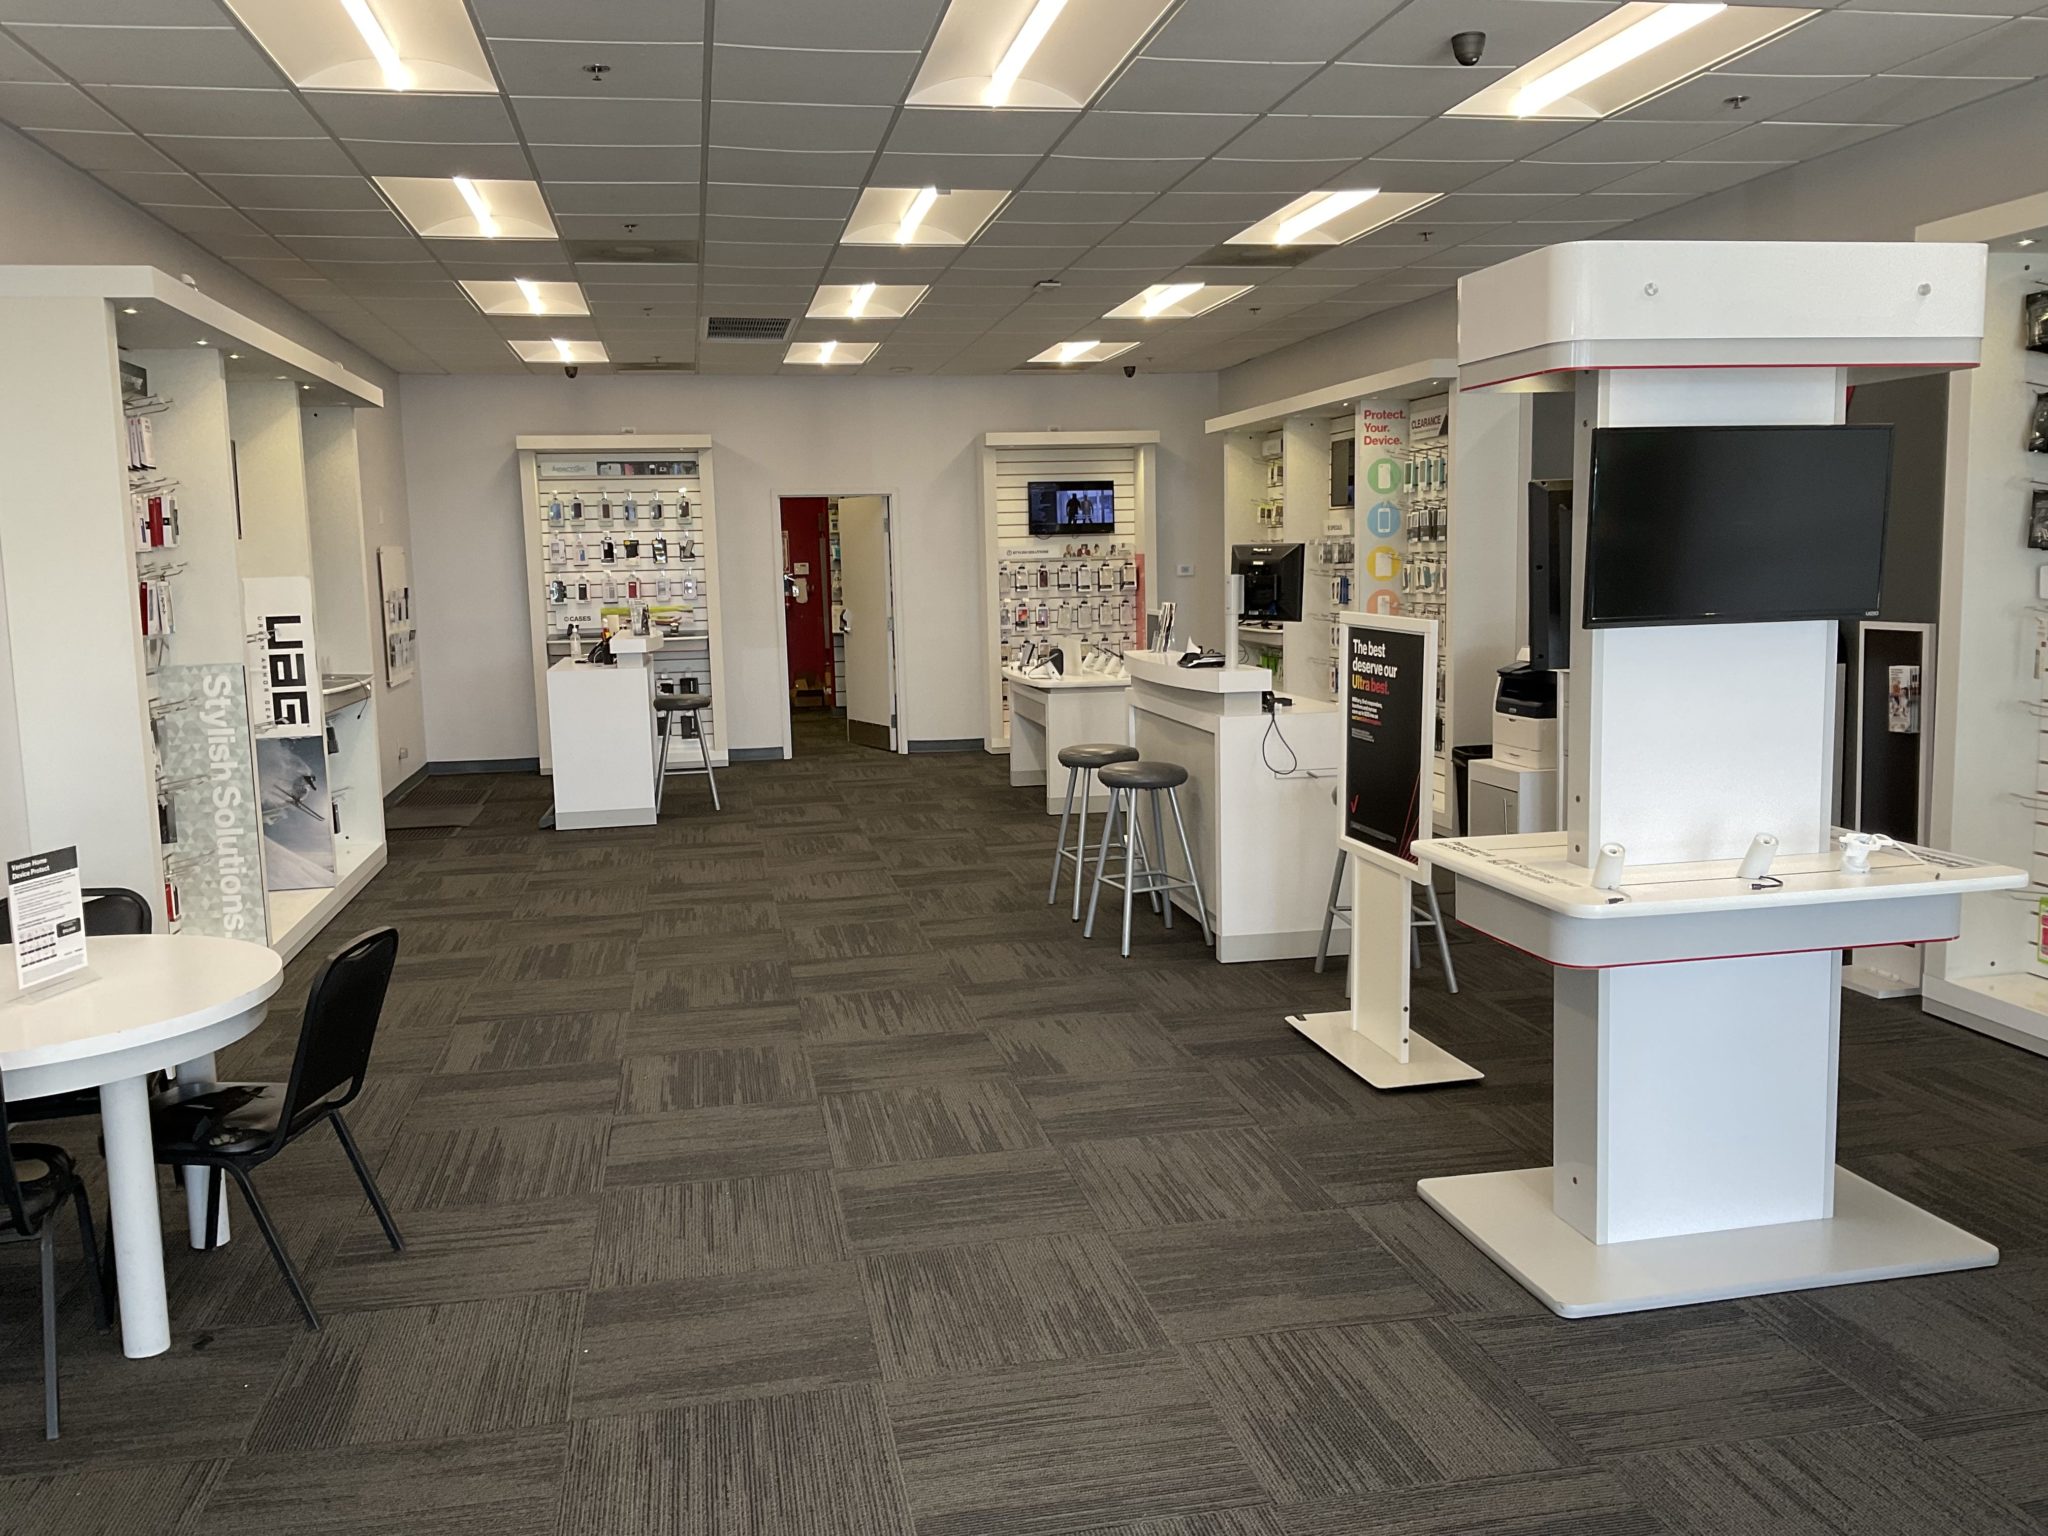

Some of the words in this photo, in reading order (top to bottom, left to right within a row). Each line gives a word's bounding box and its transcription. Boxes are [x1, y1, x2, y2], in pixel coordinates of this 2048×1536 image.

[1364, 409, 1406, 420] Protect.
[1411, 415, 1441, 429] CLEARANCE
[1364, 422, 1390, 433] Your.
[1364, 435, 1403, 446] Device.
[1352, 638, 1368, 656] The
[1368, 640, 1386, 658] best
[1352, 657, 1383, 676] deserve
[1384, 664, 1398, 678] our
[1352, 673, 1370, 691] Ultra
[1371, 678, 1390, 695] best.
[200, 674, 239, 781] Stylish
[12, 862, 31, 872] Verizon
[212, 785, 246, 938] Solutions.
[12, 871, 30, 880] Device
[30, 865, 50, 875] Protect
